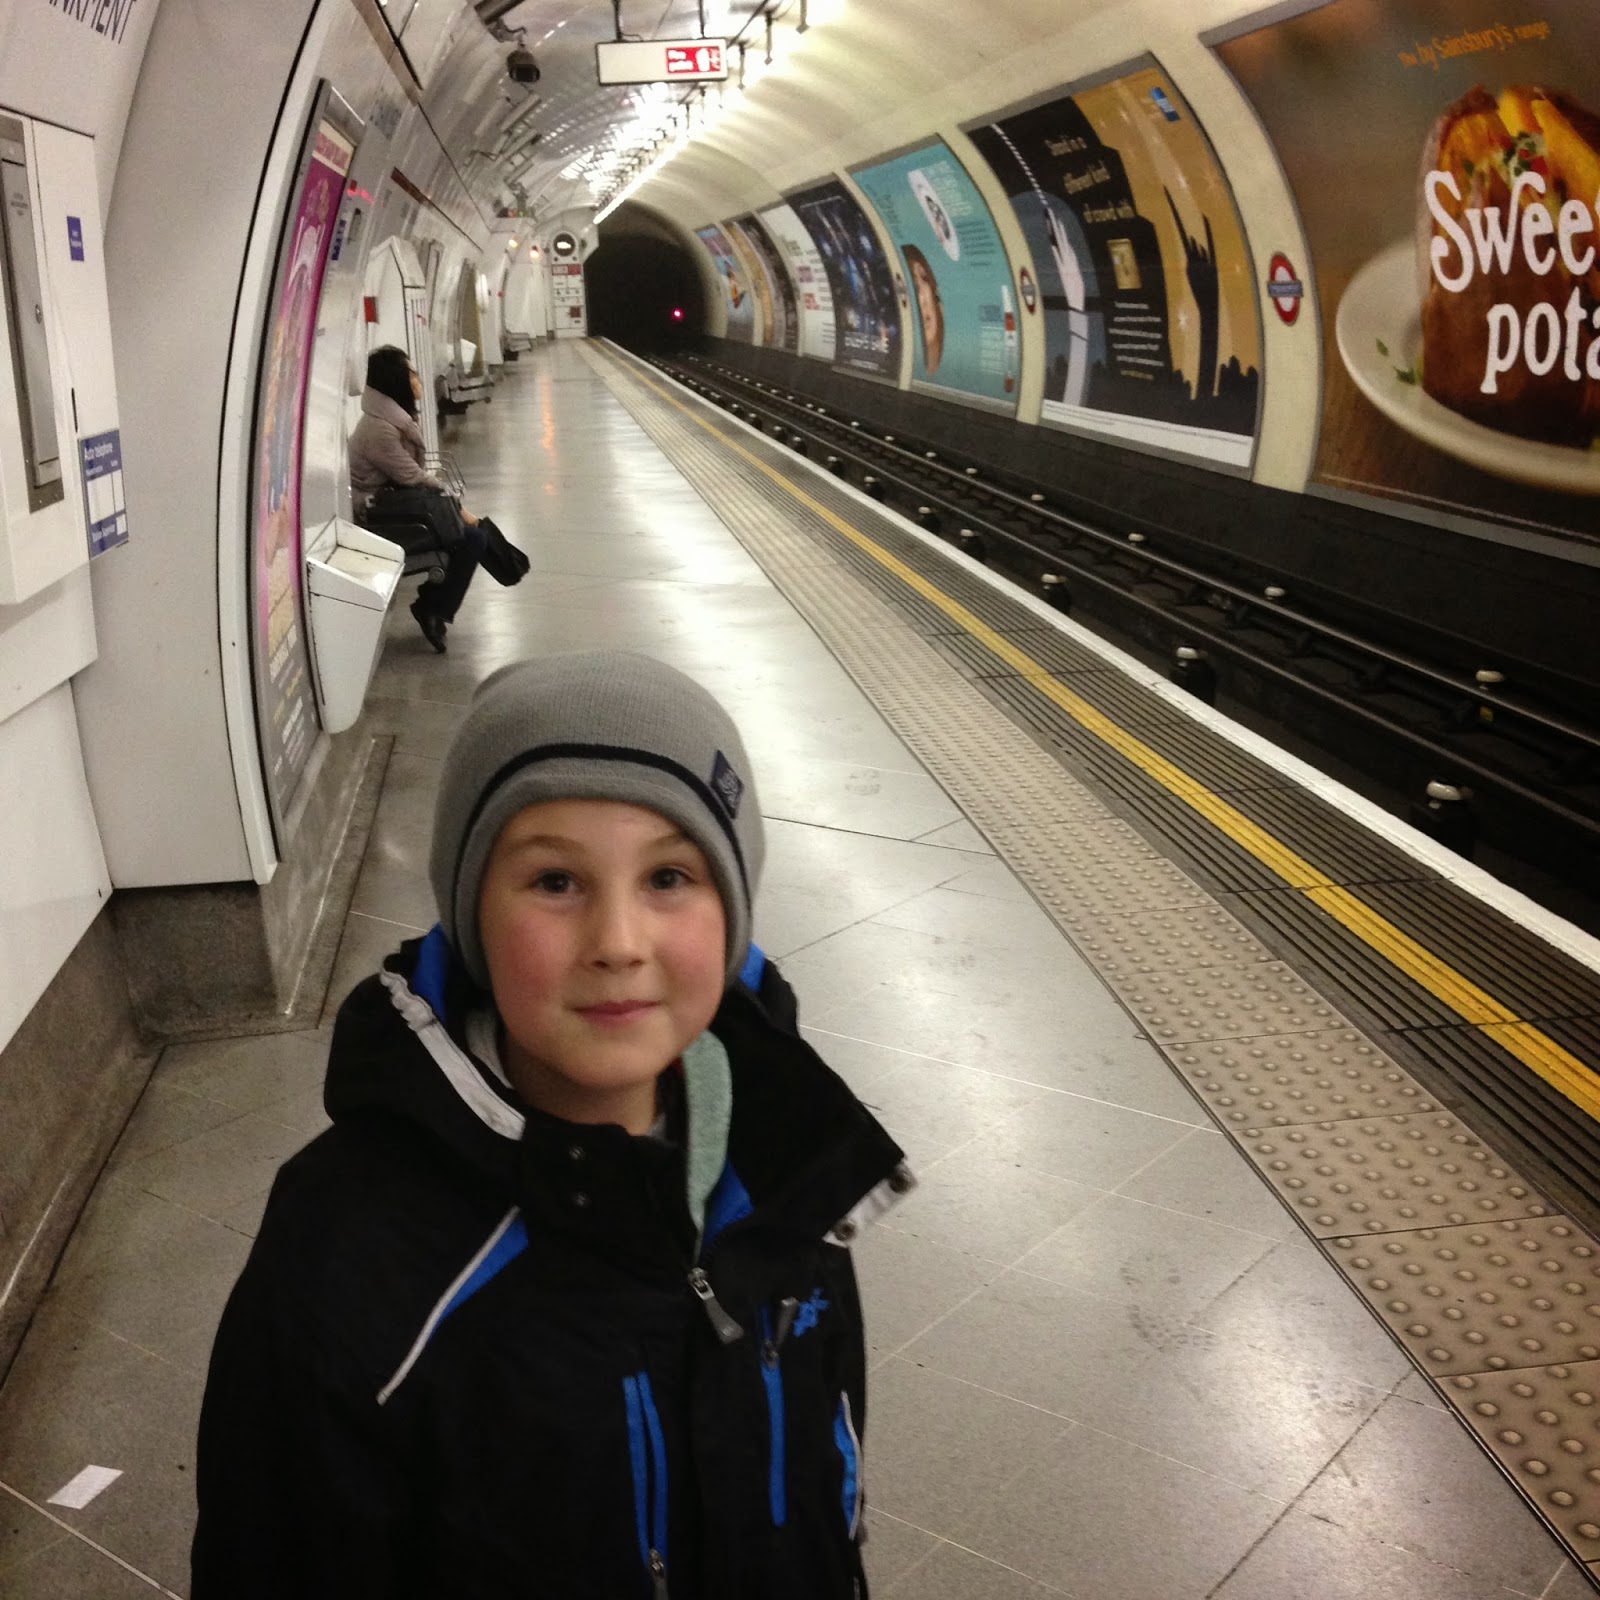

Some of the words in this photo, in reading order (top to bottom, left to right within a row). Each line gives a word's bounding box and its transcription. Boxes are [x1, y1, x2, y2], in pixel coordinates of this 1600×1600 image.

[1415, 41, 1440, 72] by
[1431, 22, 1513, 59] Sainsbury's
[1425, 171, 1600, 292] Swee
